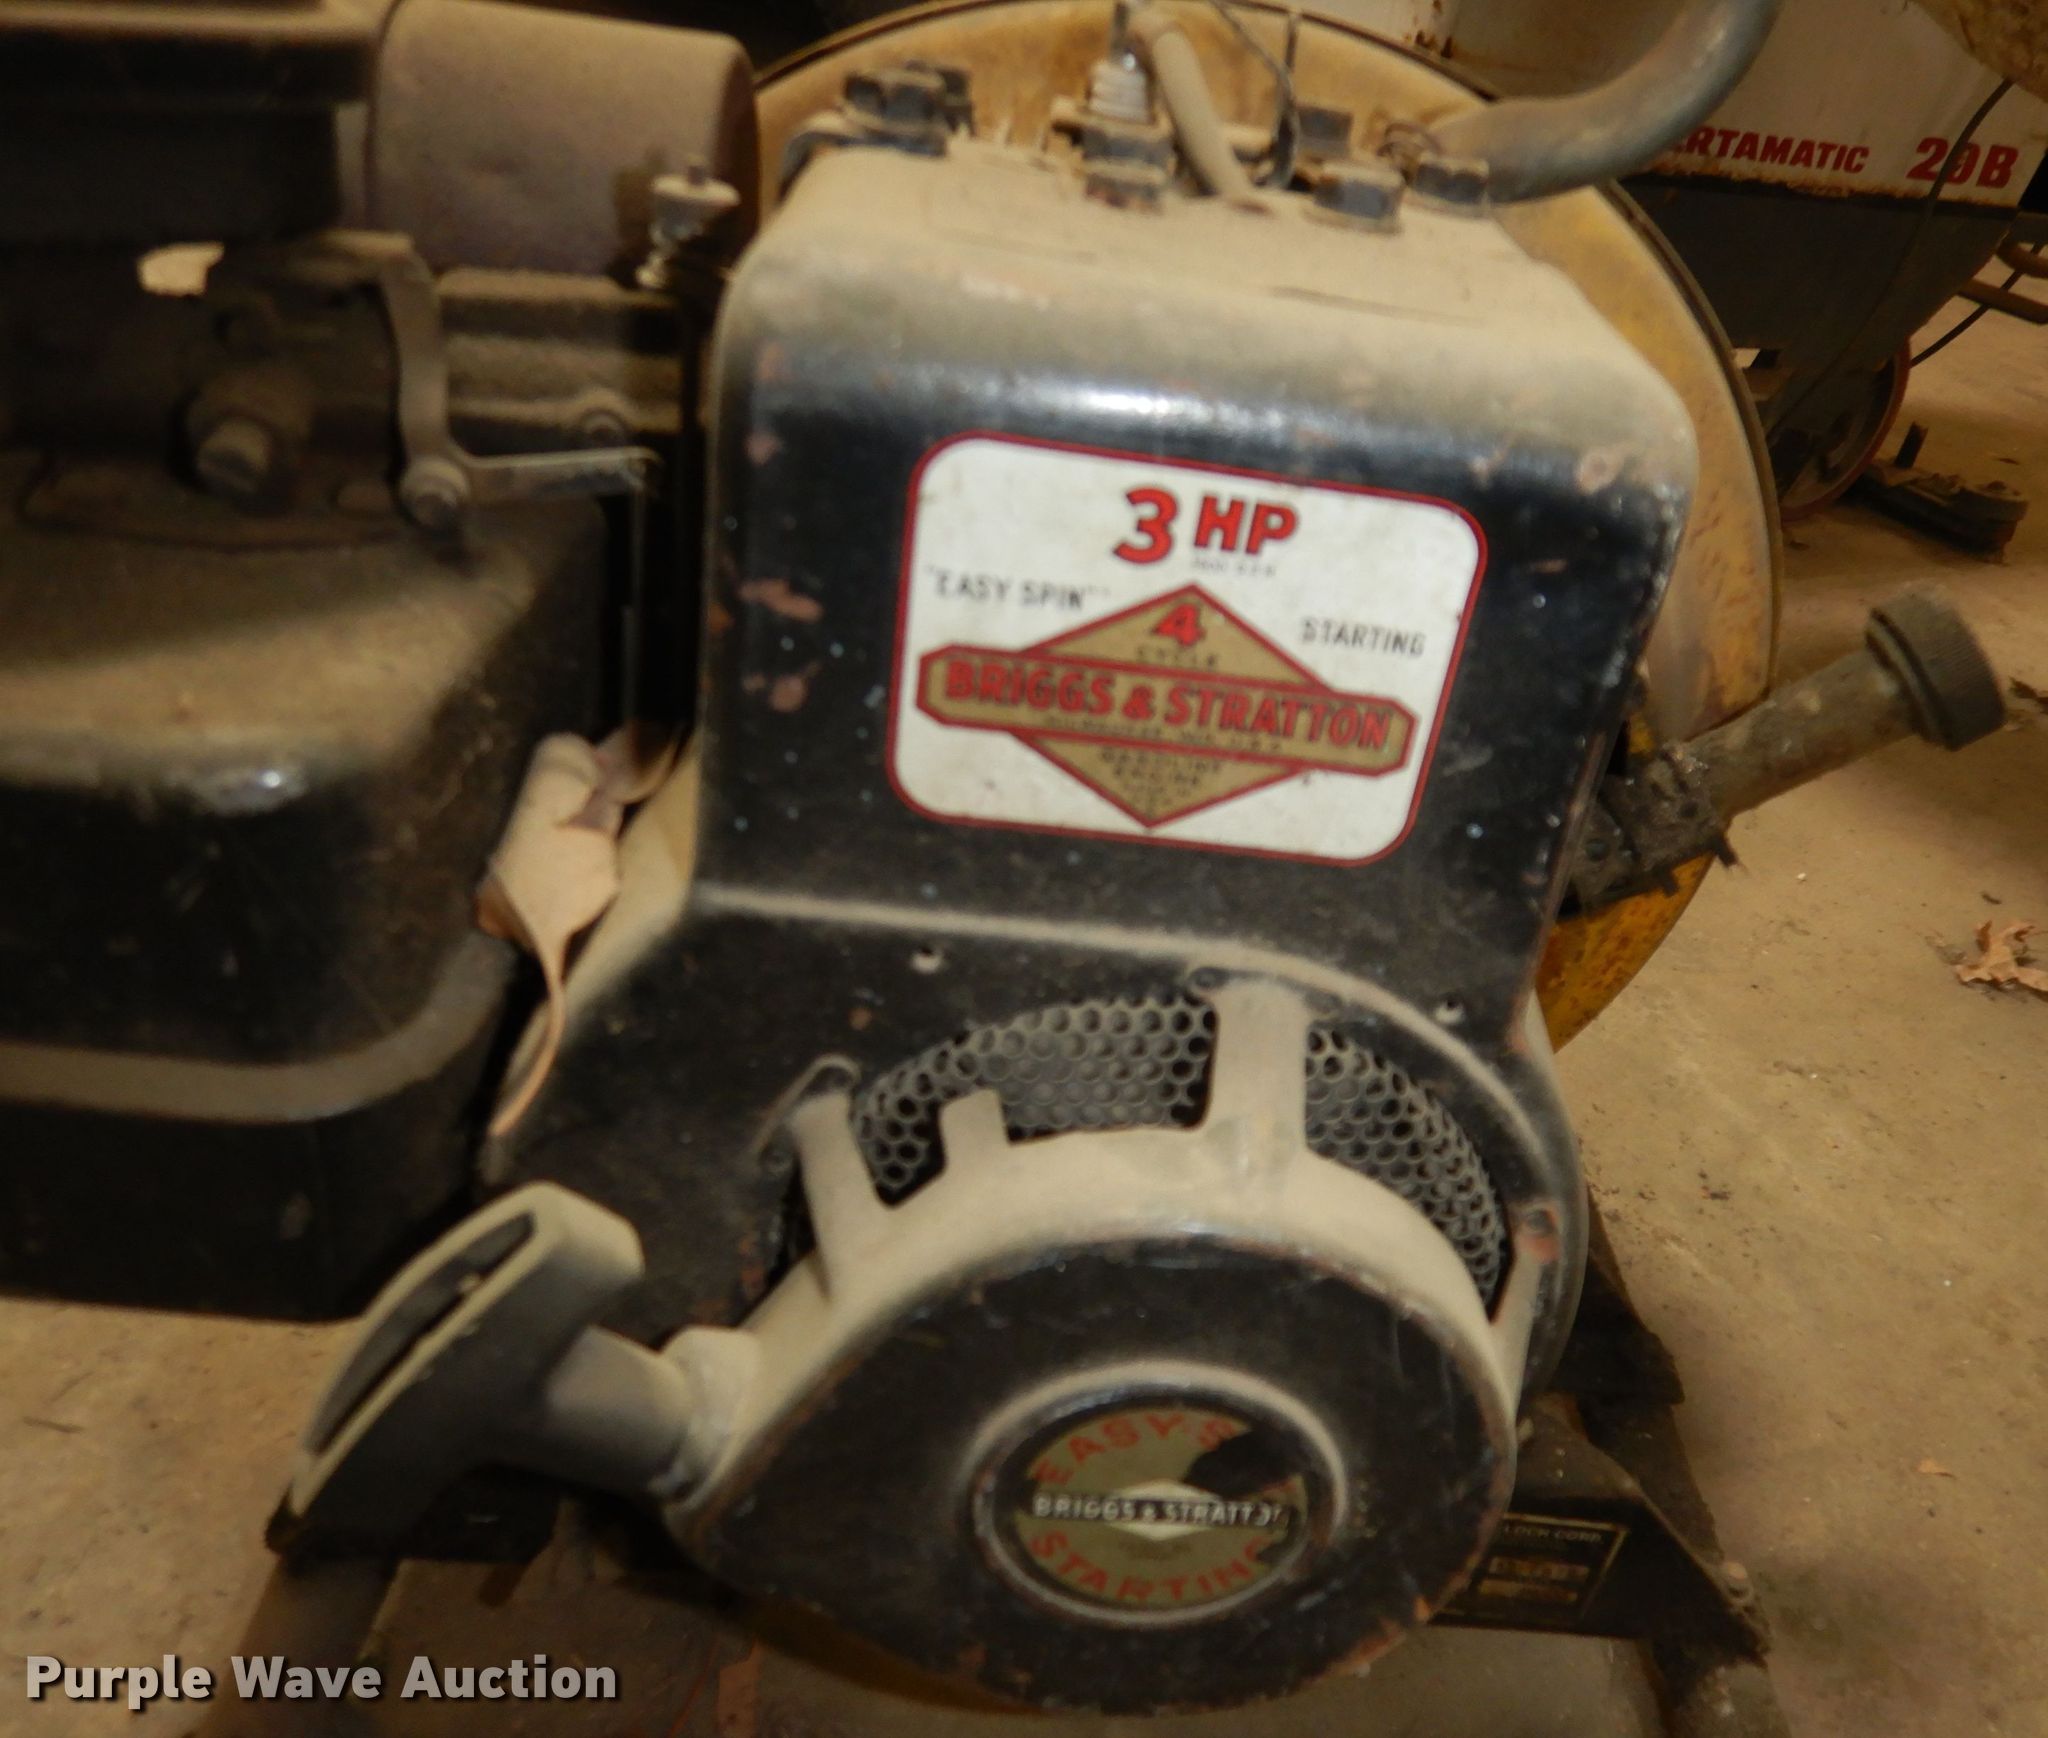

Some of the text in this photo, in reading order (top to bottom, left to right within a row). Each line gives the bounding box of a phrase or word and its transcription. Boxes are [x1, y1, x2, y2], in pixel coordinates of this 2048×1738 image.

[1673, 124, 2019, 189] RTAMATIC 20B
[1111, 486, 1299, 565] 3 HP
[1149, 602, 1207, 647] 4
[1299, 616, 1427, 658] STARTING
[944, 659, 1117, 718] BRIGGS
[1121, 683, 1155, 721] &
[1161, 687, 1392, 753] STRATTON
[1028, 1411, 1187, 1487] EASY
[1031, 1495, 1136, 1523] BRIGGS
